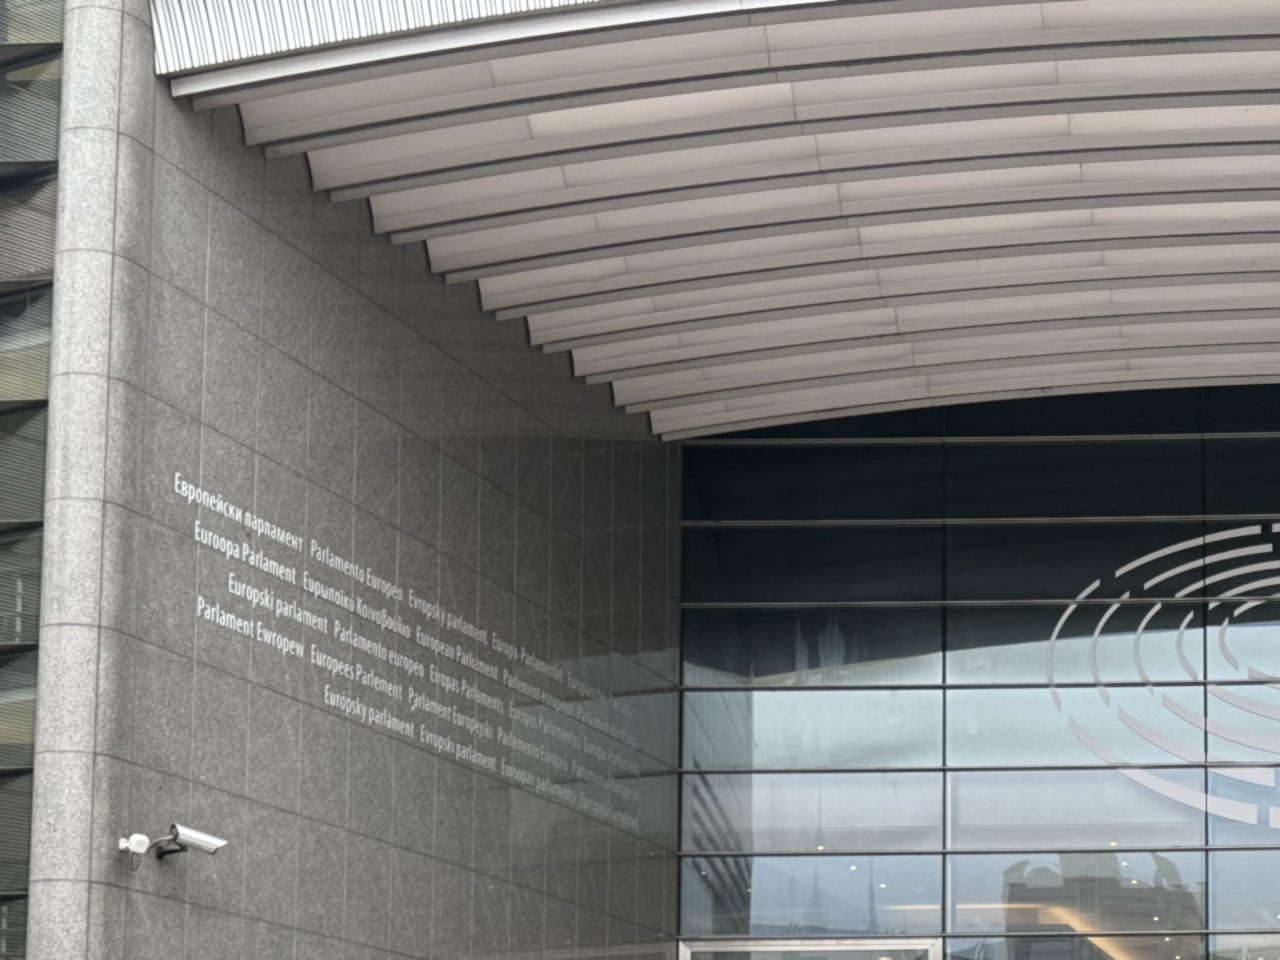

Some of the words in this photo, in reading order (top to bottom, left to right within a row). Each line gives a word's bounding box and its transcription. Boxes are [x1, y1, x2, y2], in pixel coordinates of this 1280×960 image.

[174, 472, 242, 523] Европейски
[245, 511, 304, 552] парламент
[195, 520, 240, 559] Euroopa
[242, 542, 296, 585] Parlament
[311, 539, 365, 583] Parlamento
[366, 568, 403, 602] Europeo
[408, 589, 446, 627] Evropský
[447, 612, 487, 645] parlament
[198, 596, 254, 638] Parlament
[256, 621, 304, 658] Ewropew
[311, 643, 354, 680] Europees
[356, 664, 402, 700] Parlement
[409, 686, 451, 721] Parlament
[228, 572, 274, 610] Europski
[276, 598, 328, 634] parlament
[334, 619, 387, 661] Parlamento
[388, 649, 424, 678] europeo
[416, 625, 455, 660] European
[324, 684, 367, 723] Európsky
[368, 707, 414, 738] parlament
